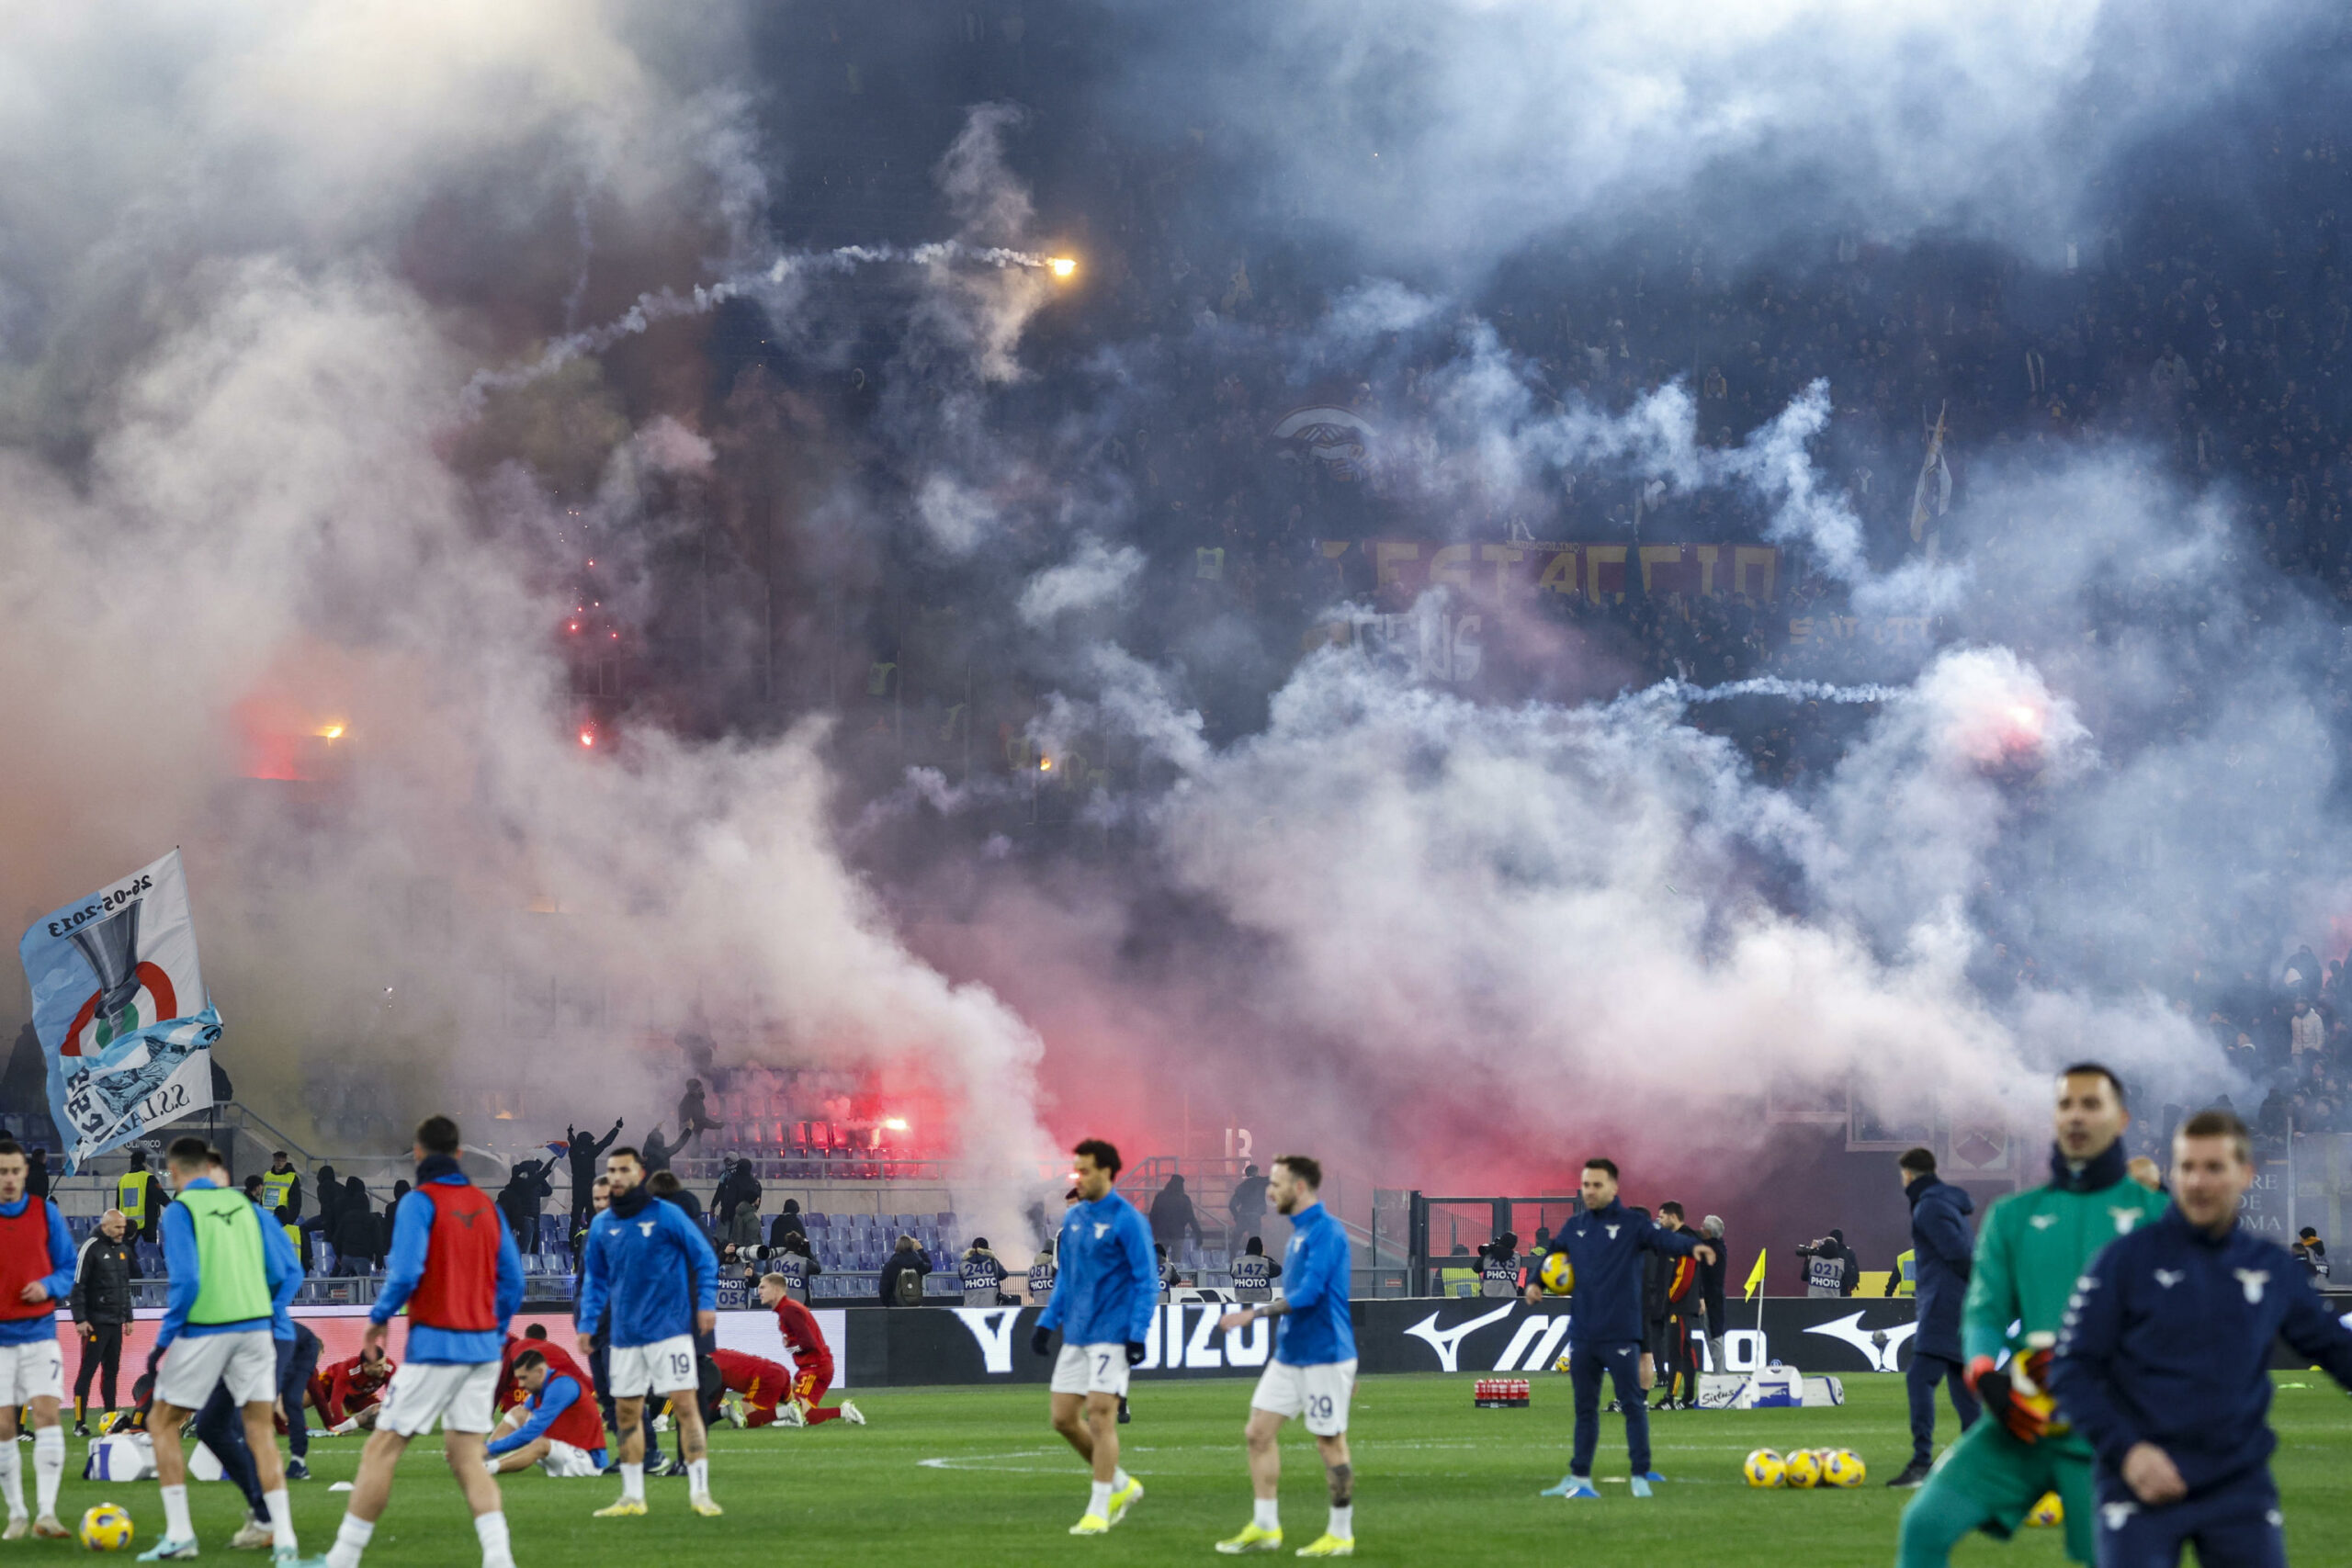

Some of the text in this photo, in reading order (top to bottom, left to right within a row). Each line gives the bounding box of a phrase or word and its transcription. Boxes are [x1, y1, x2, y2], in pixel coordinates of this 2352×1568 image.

[774, 1259, 800, 1274] 064
[965, 1262, 992, 1276] 240
[1237, 1263, 1264, 1275] 147
[1814, 1262, 1839, 1277] 021
[1235, 1278, 1267, 1287] PHOTO
[1811, 1276, 1840, 1288] PHOTO
[50, 1359, 60, 1380] 7
[670, 1353, 691, 1375] 19
[1097, 1354, 1110, 1376] 7
